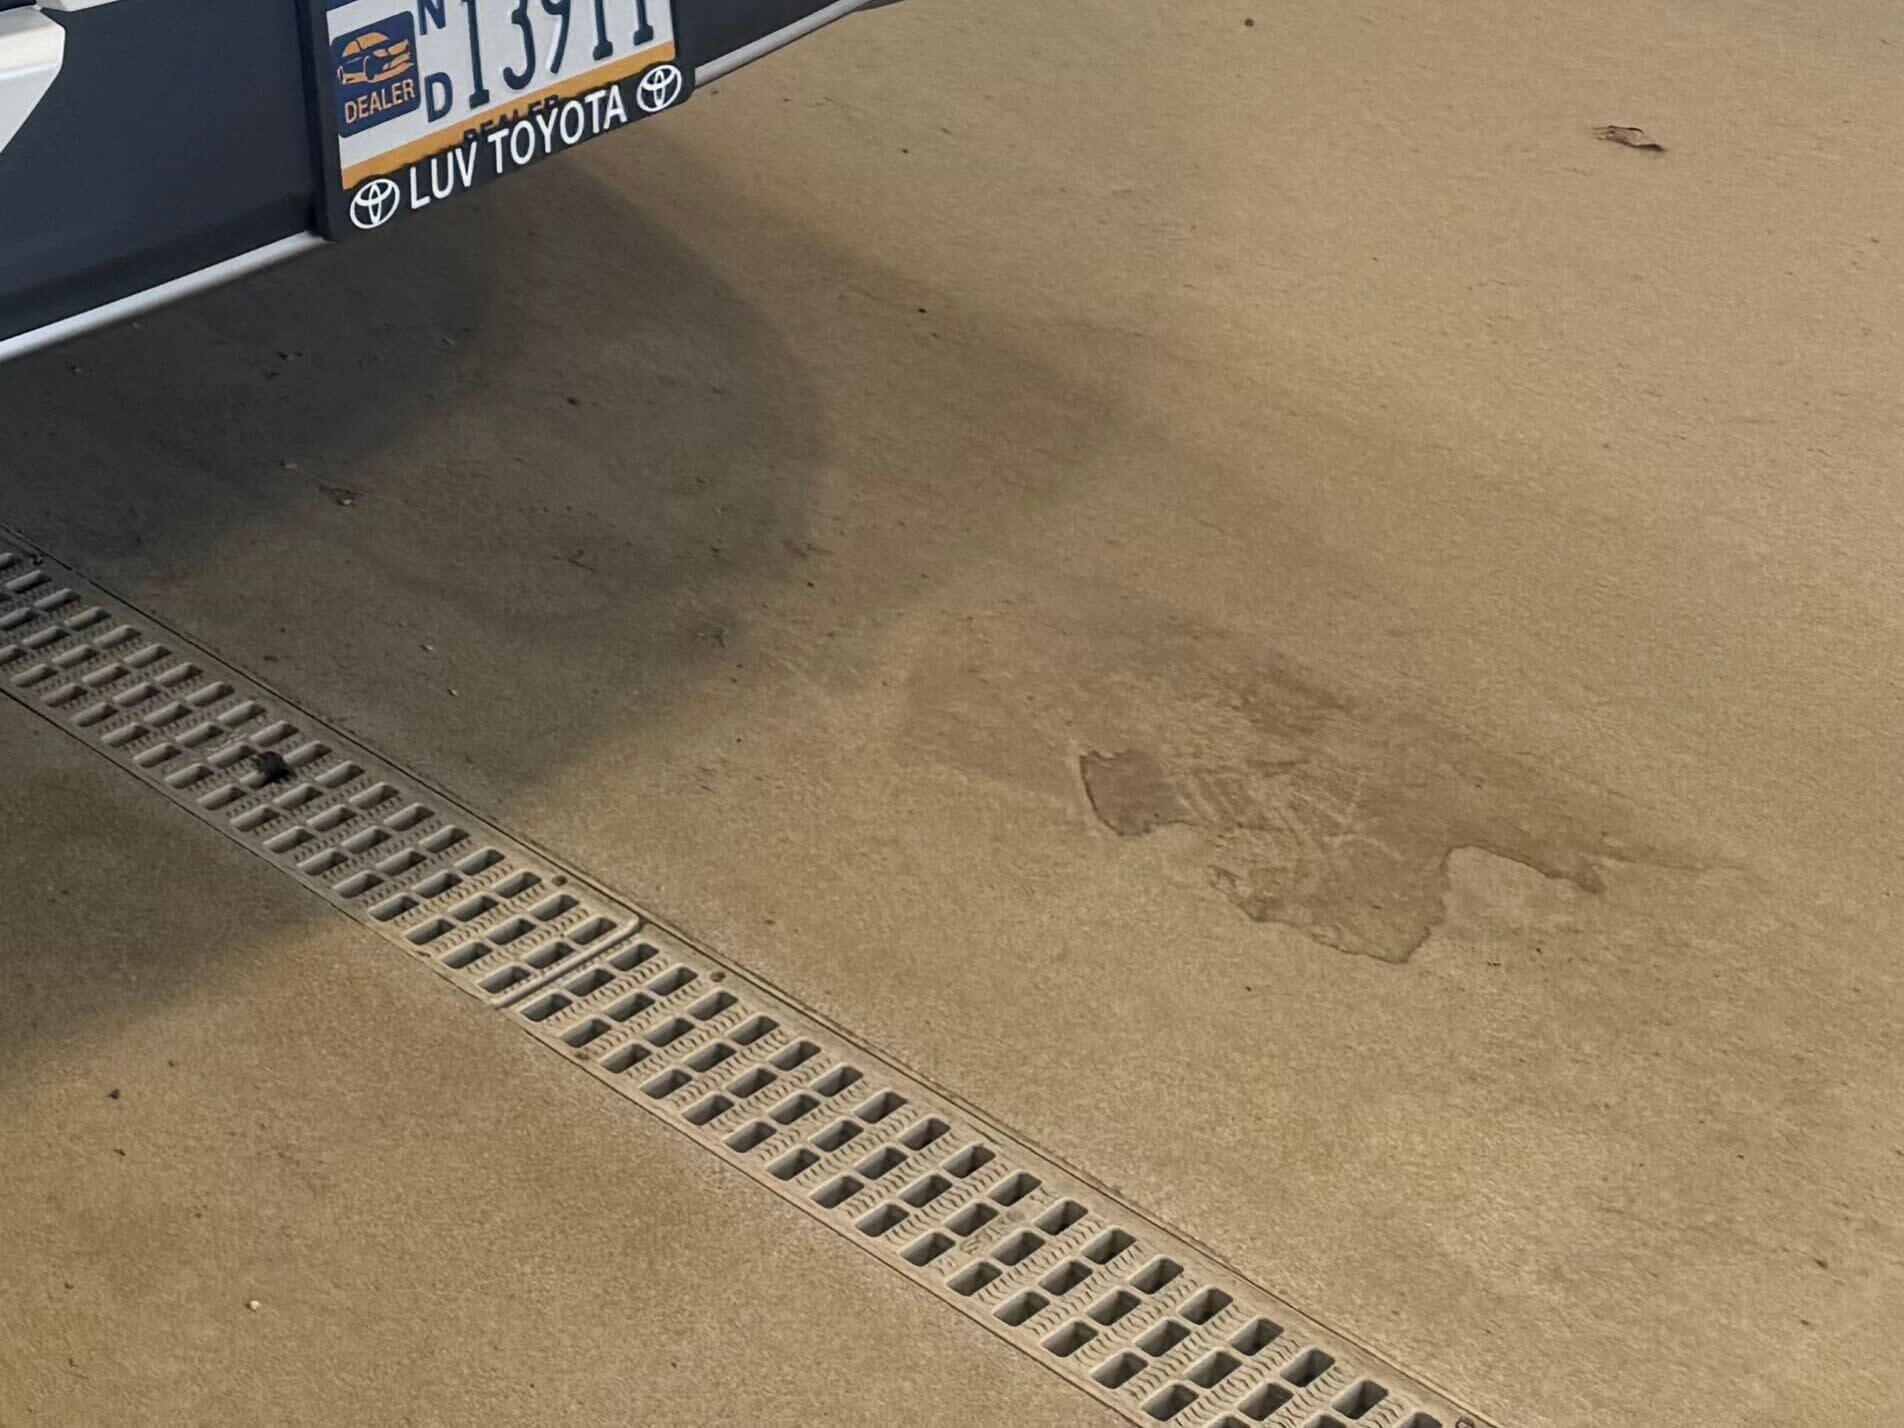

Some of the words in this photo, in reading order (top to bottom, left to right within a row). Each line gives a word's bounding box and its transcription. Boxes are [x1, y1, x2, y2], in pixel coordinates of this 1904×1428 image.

[344, 79, 415, 124] DEALER
[409, 141, 478, 210] LUV
[487, 84, 628, 174] TOYOTA
